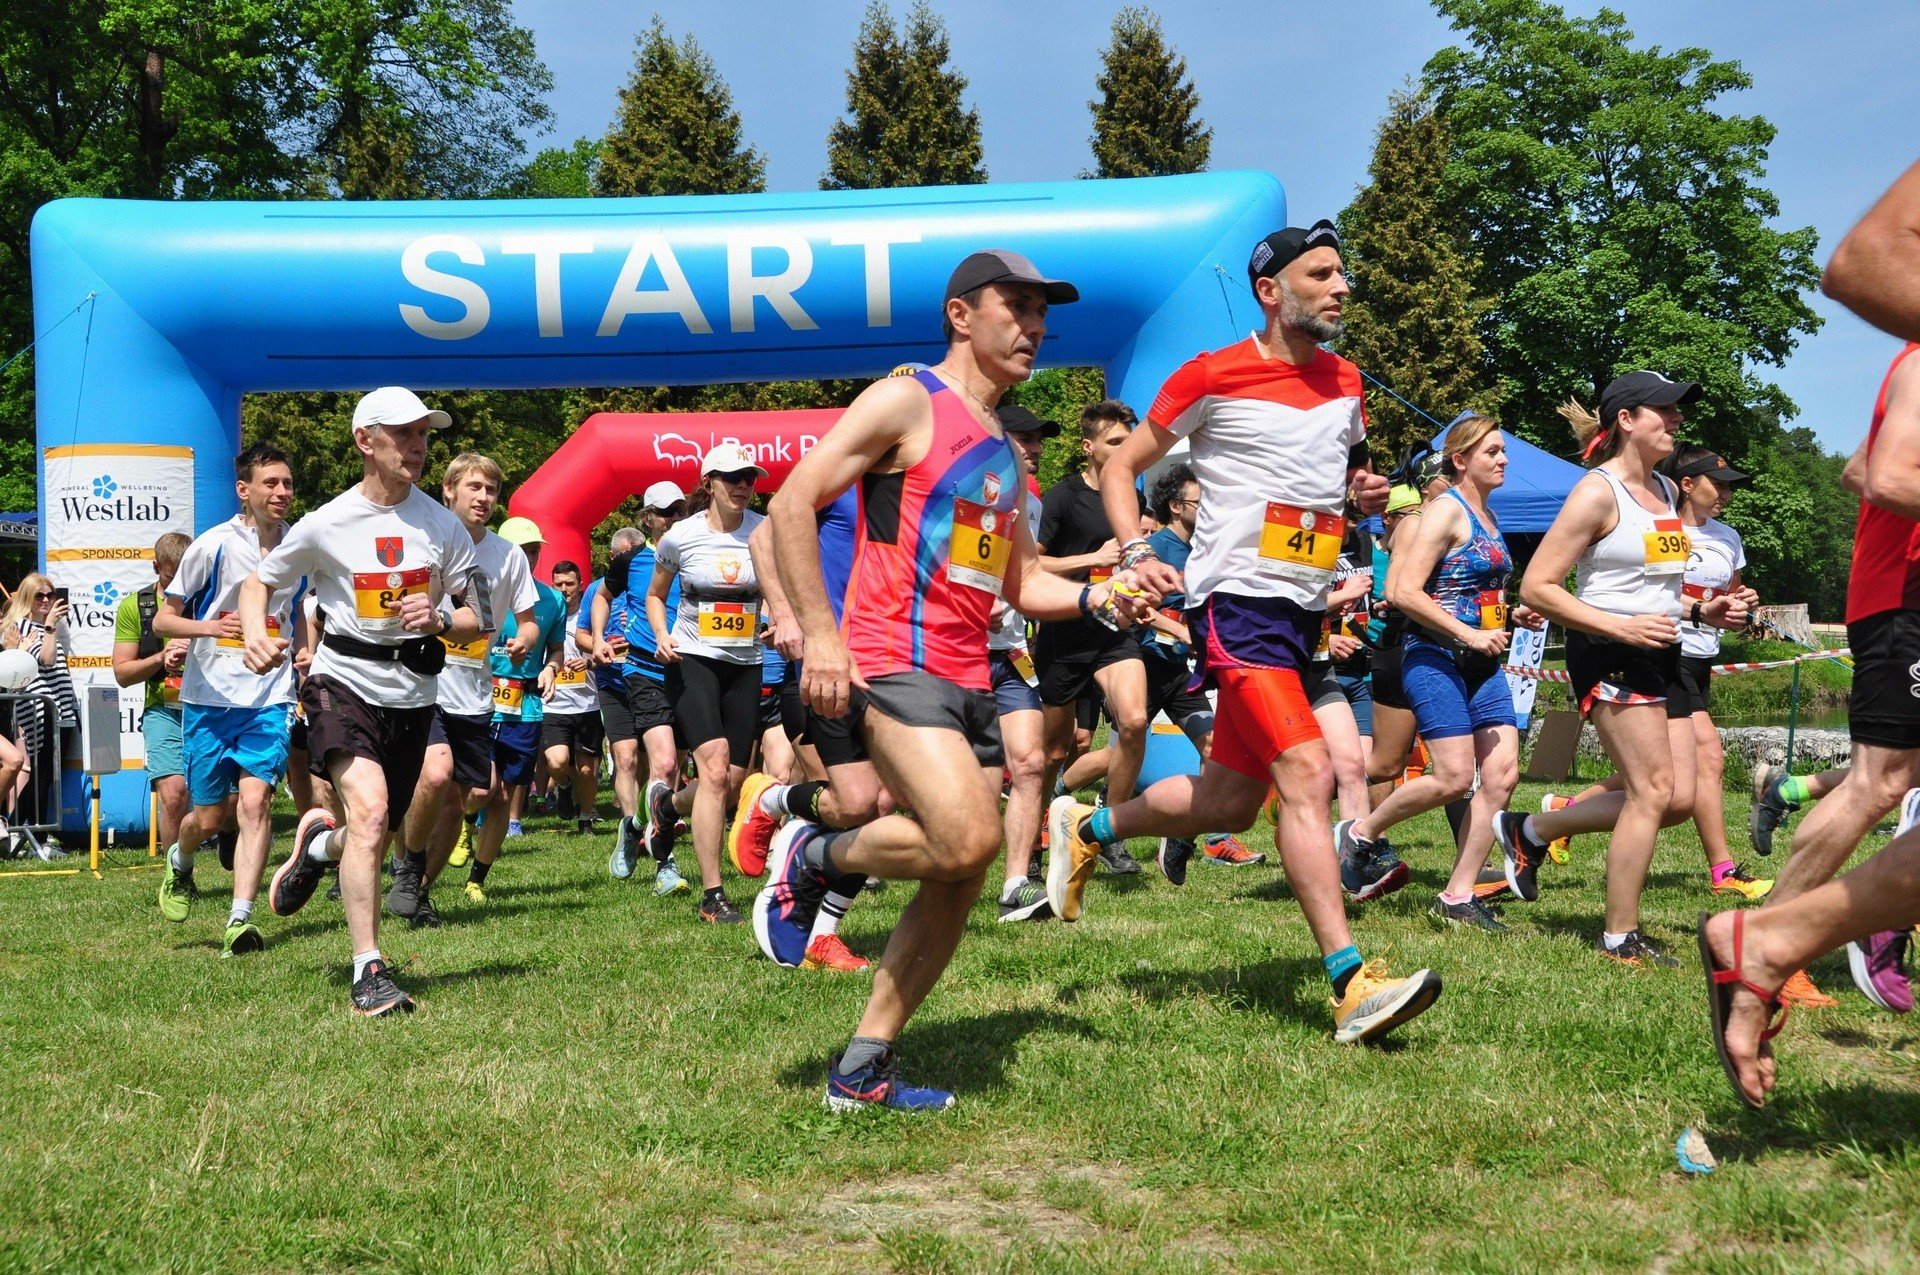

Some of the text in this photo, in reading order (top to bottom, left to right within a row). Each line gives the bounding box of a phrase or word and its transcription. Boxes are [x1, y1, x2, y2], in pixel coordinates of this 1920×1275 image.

[398, 226, 922, 341] START
[60, 495, 170, 522] Westlab
[977, 533, 991, 560] 6
[1286, 530, 1316, 556] 41
[1657, 535, 1688, 554] 396
[81, 549, 142, 559] SPONSOR
[66, 603, 117, 628] Wes
[711, 616, 745, 631] 349
[69, 656, 113, 667] STRATE
[561, 672, 575, 681] 58
[492, 686, 511, 700] 96
